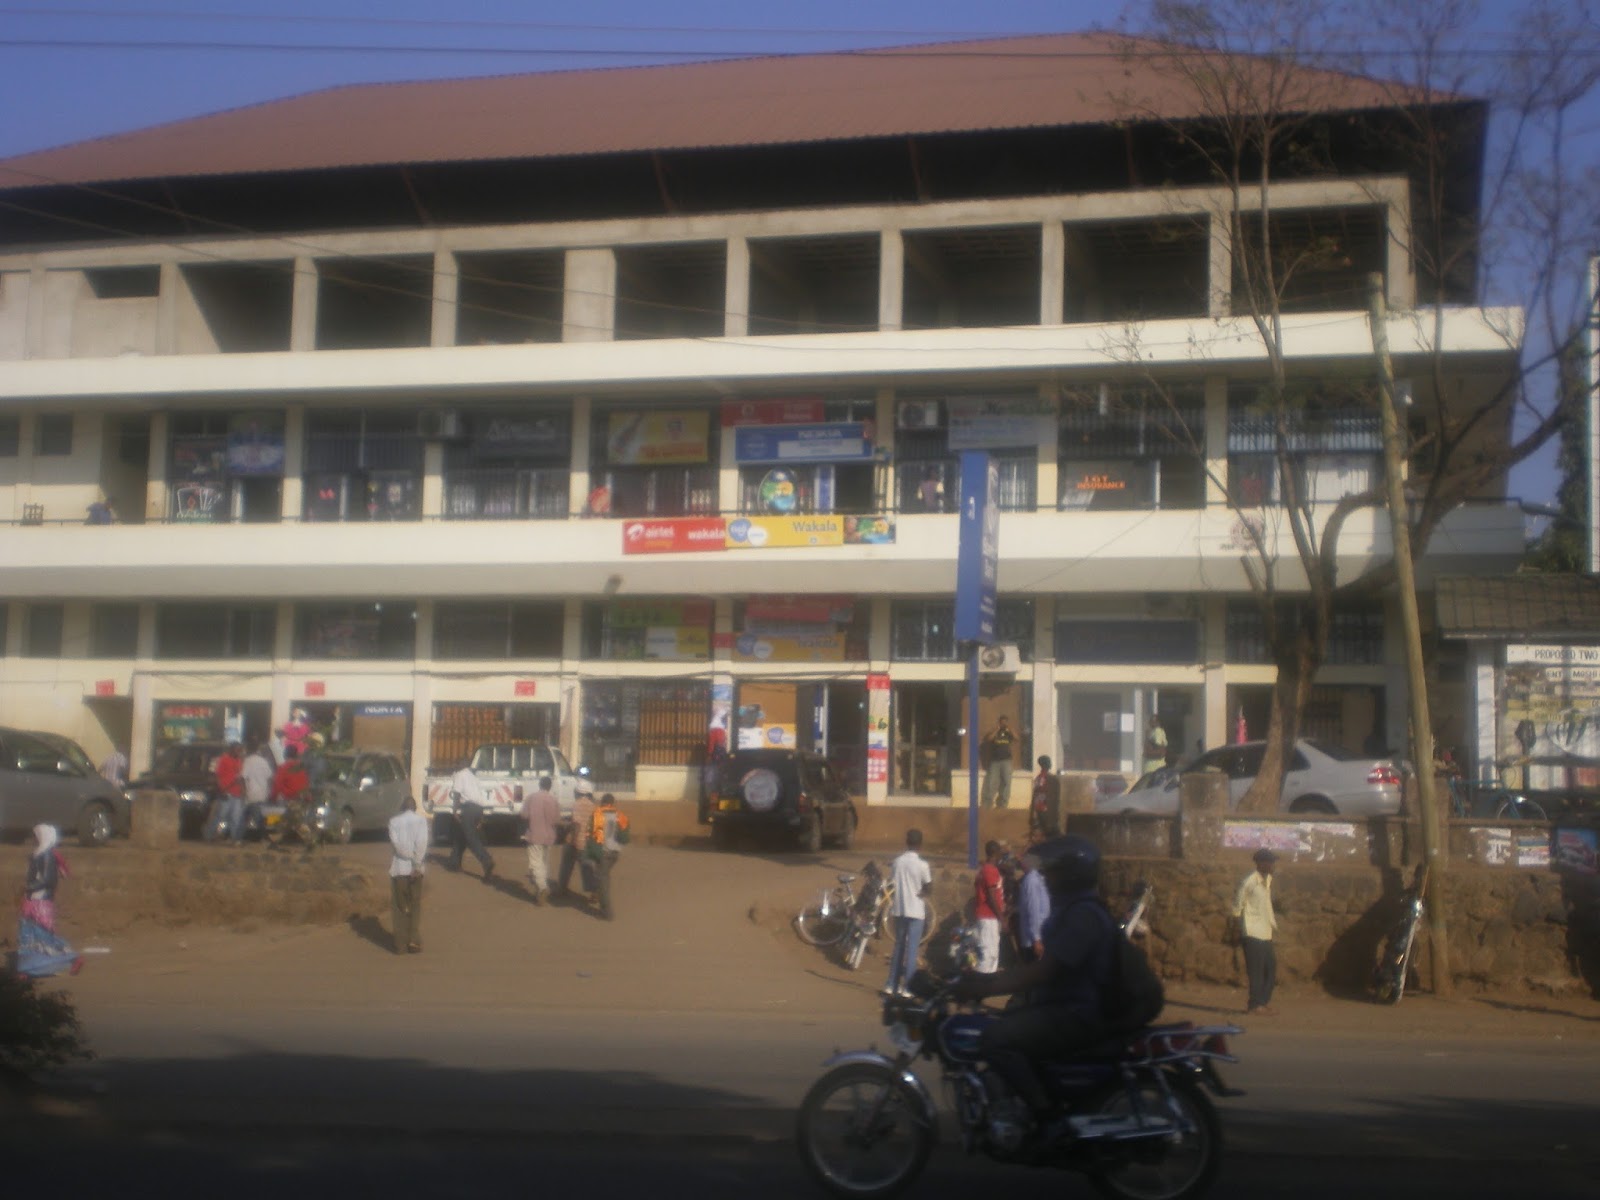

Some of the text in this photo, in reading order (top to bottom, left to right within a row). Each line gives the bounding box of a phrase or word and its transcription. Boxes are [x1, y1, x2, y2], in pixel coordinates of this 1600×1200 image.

[644, 526, 675, 539] airtel
[792, 519, 838, 533] Wakala
[687, 527, 726, 541] wakala
